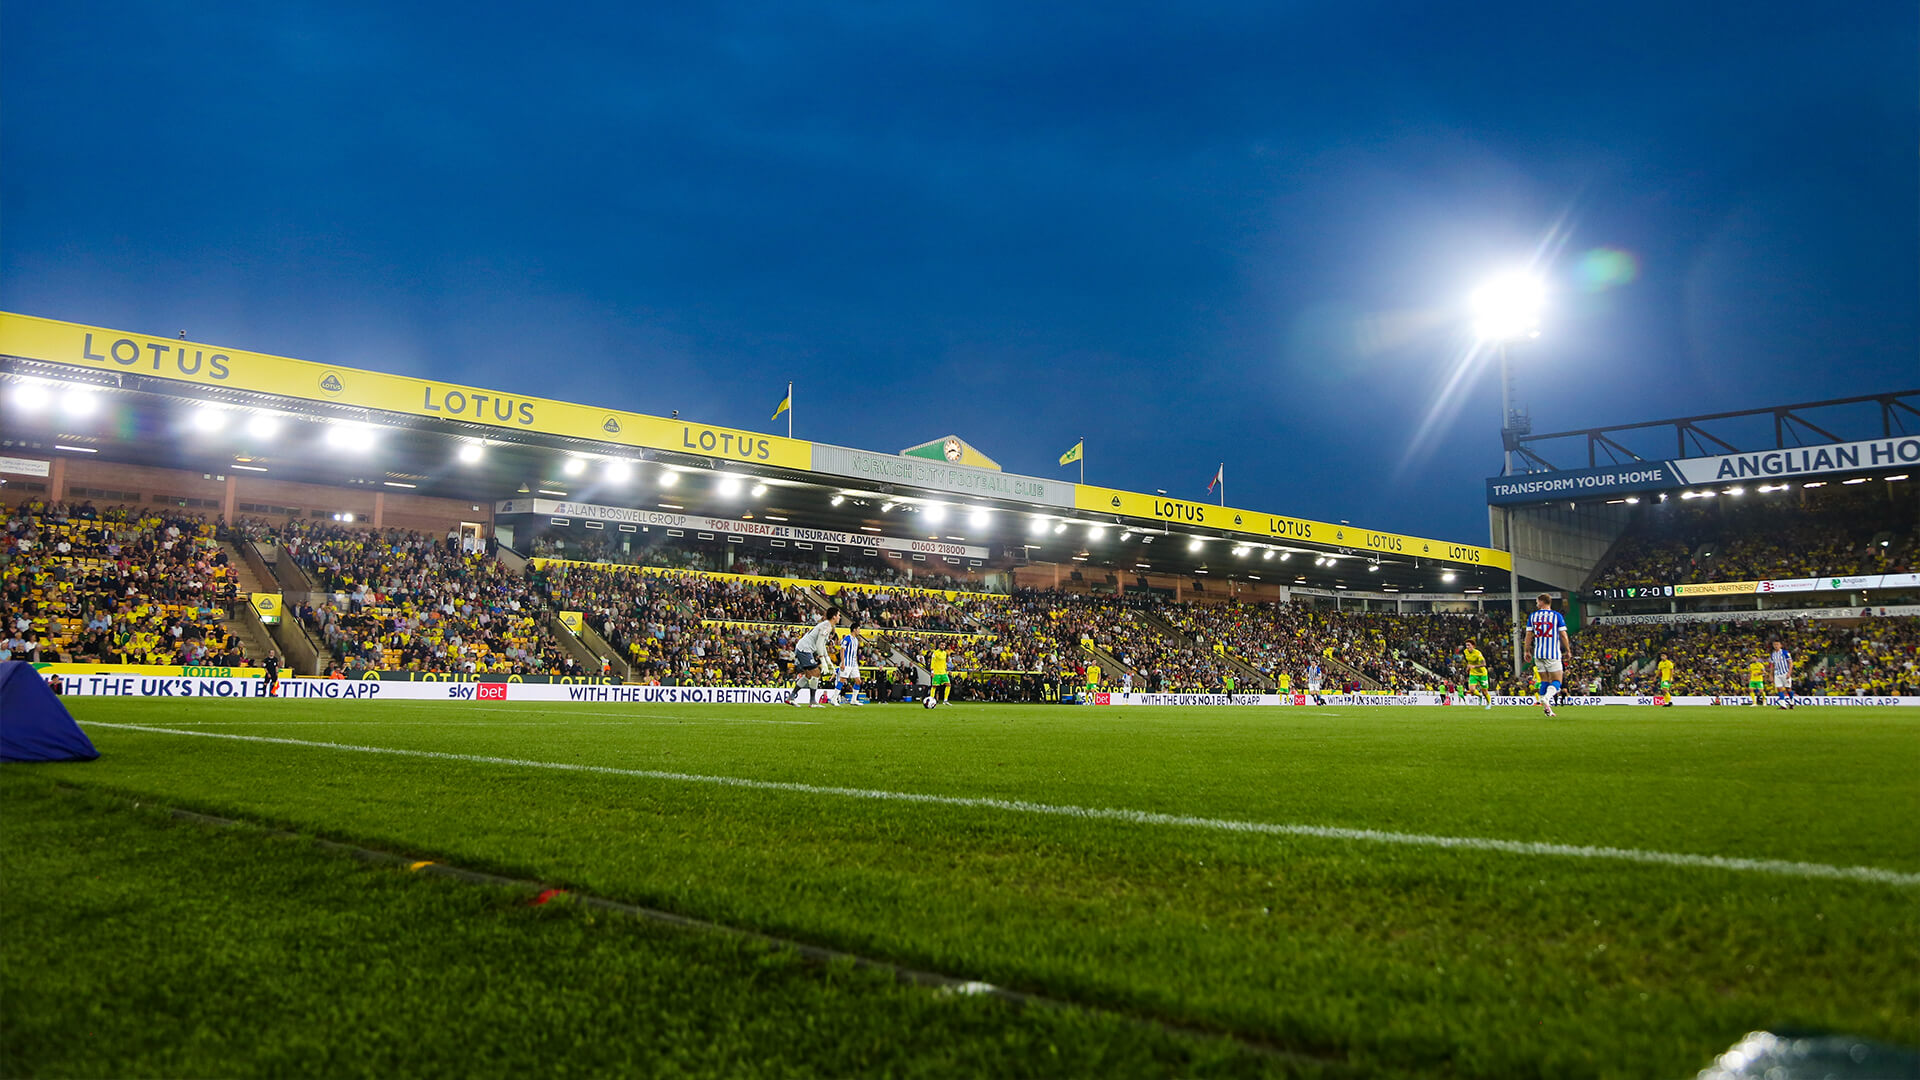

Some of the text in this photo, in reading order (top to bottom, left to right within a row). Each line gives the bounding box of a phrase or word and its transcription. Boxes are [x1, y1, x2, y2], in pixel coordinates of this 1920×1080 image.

[83, 333, 230, 379] LOTUS
[424, 386, 535, 426] LOTUS
[683, 427, 770, 460] LOTUS
[1717, 445, 1860, 479] ANGLIAN
[853, 456, 1045, 497] NORWICH CITY FOOTBALL CLUB
[1493, 469, 1662, 496] TRANSFORM YOUR HOME
[567, 504, 686, 526] ALAN BOSWELL GROUP
[1155, 500, 1204, 522] LOTUS
[705, 520, 730, 531] "FOR
[794, 529, 846, 543] INSURANCE
[850, 535, 885, 547] ADVICE"
[1270, 518, 1311, 538] LOTUS
[911, 541, 966, 555] 01603 218000
[1367, 533, 1402, 551] LOTUS
[1448, 545, 1480, 562] LOTUS
[1640, 587, 1660, 597] 2-0
[1684, 583, 1755, 593] REGIONAL PARTNERS
[1605, 617, 1628, 626] ALAN
[1631, 615, 1671, 624] BOSWELL
[1533, 621, 1554, 638] 32
[89, 678, 134, 695] THE
[141, 679, 193, 697] UK'S
[199, 680, 248, 697] NO.1
[343, 683, 380, 698] APP
[449, 684, 504, 700] sky bet
[569, 687, 608, 701] WITH
[612, 688, 640, 701] THE
[644, 689, 676, 702] UK'S
[681, 689, 713, 702] NO.1
[717, 690, 771, 703] BETTING
[1096, 693, 1109, 704] bet
[1140, 695, 1160, 705] WITH
[1163, 695, 1178, 705] THE
[1180, 695, 1197, 705] UK'S
[1198, 695, 1215, 706] NO.1
[1247, 696, 1261, 705] APP
[1328, 697, 1342, 706] WITH
[1498, 697, 1517, 706] UK'S
[1583, 697, 1602, 706] APP
[1637, 697, 1665, 706] sky be
[1824, 697, 1869, 706] BETTING
[1872, 697, 1900, 706] APP
